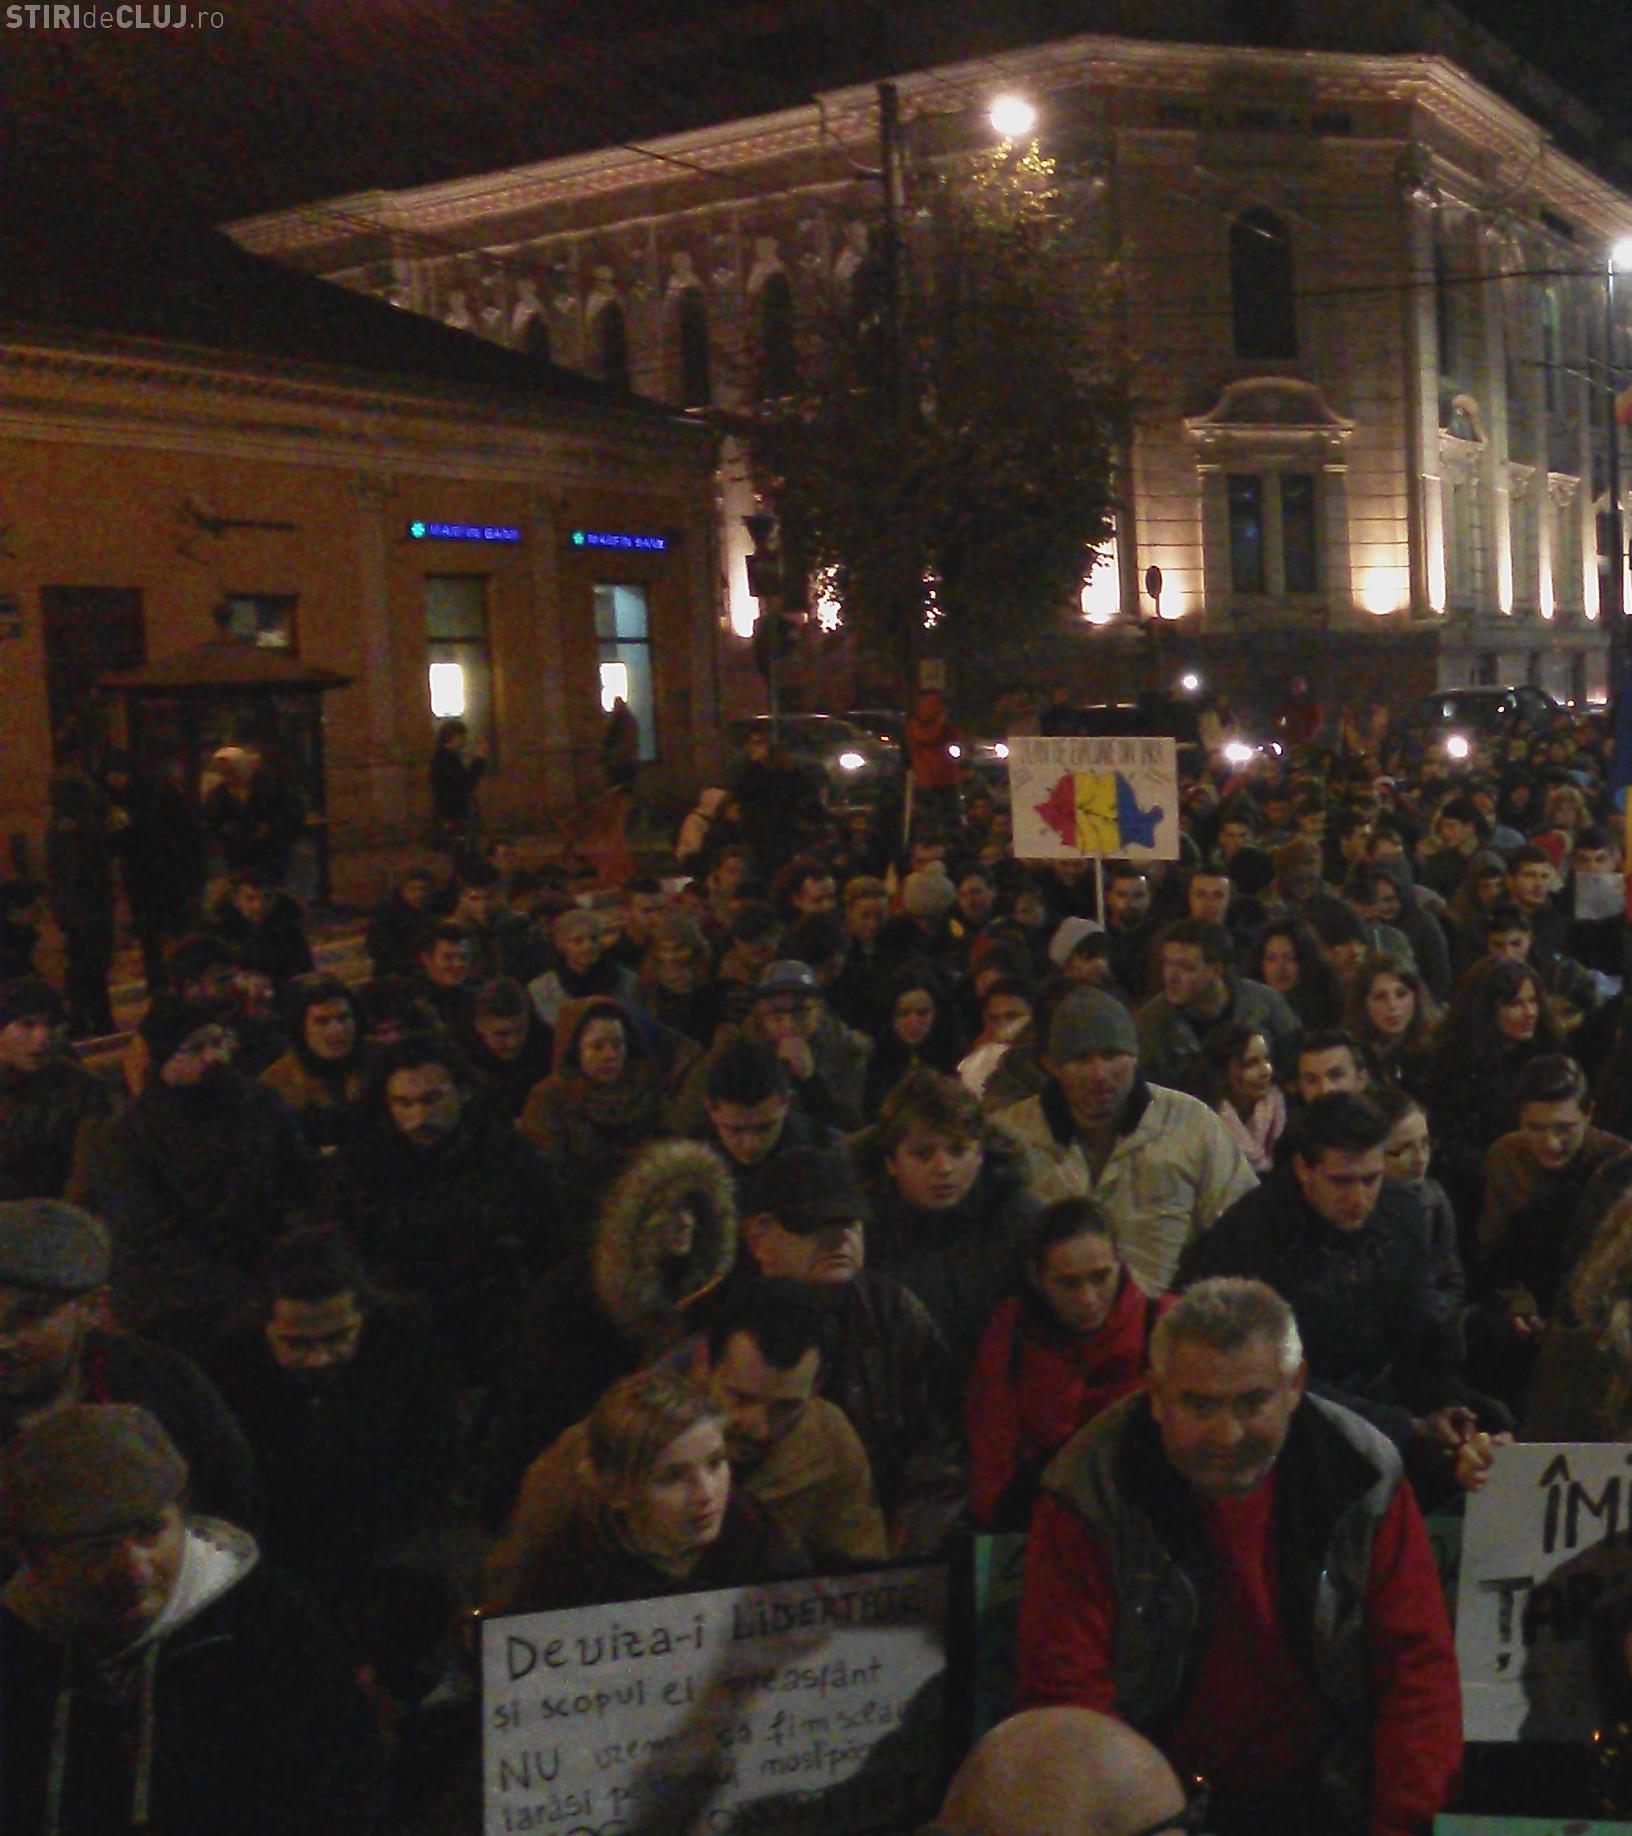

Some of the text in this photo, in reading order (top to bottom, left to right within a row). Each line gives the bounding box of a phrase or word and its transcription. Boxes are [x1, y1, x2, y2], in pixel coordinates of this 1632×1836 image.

[587, 533, 666, 550] MARFIN BANK
[542, 1680, 646, 1719] scopul
[499, 1749, 561, 1793] NU
